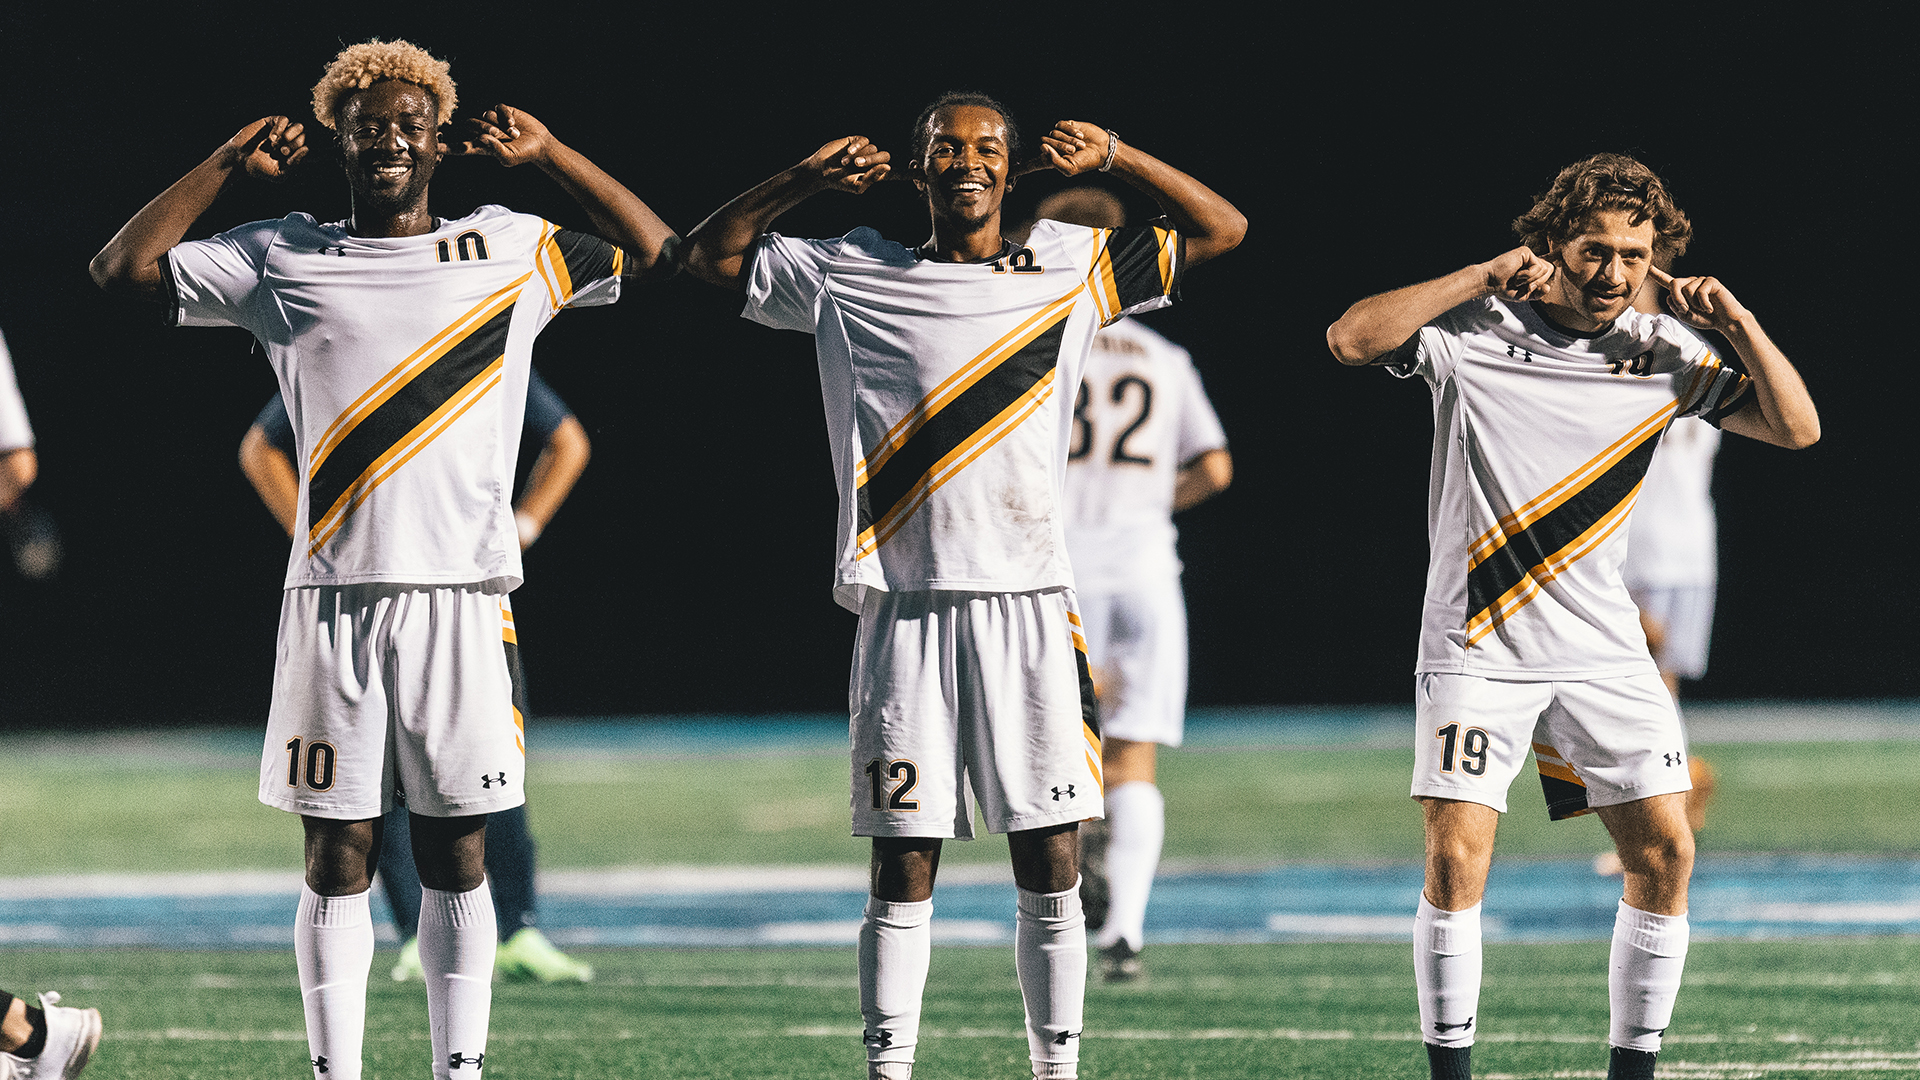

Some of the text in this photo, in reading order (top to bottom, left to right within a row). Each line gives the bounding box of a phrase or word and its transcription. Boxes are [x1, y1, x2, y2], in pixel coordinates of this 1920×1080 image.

[990, 245, 1045, 275] 2
[286, 735, 337, 792] 10
[1436, 721, 1490, 778] 19
[865, 758, 920, 812] 12
